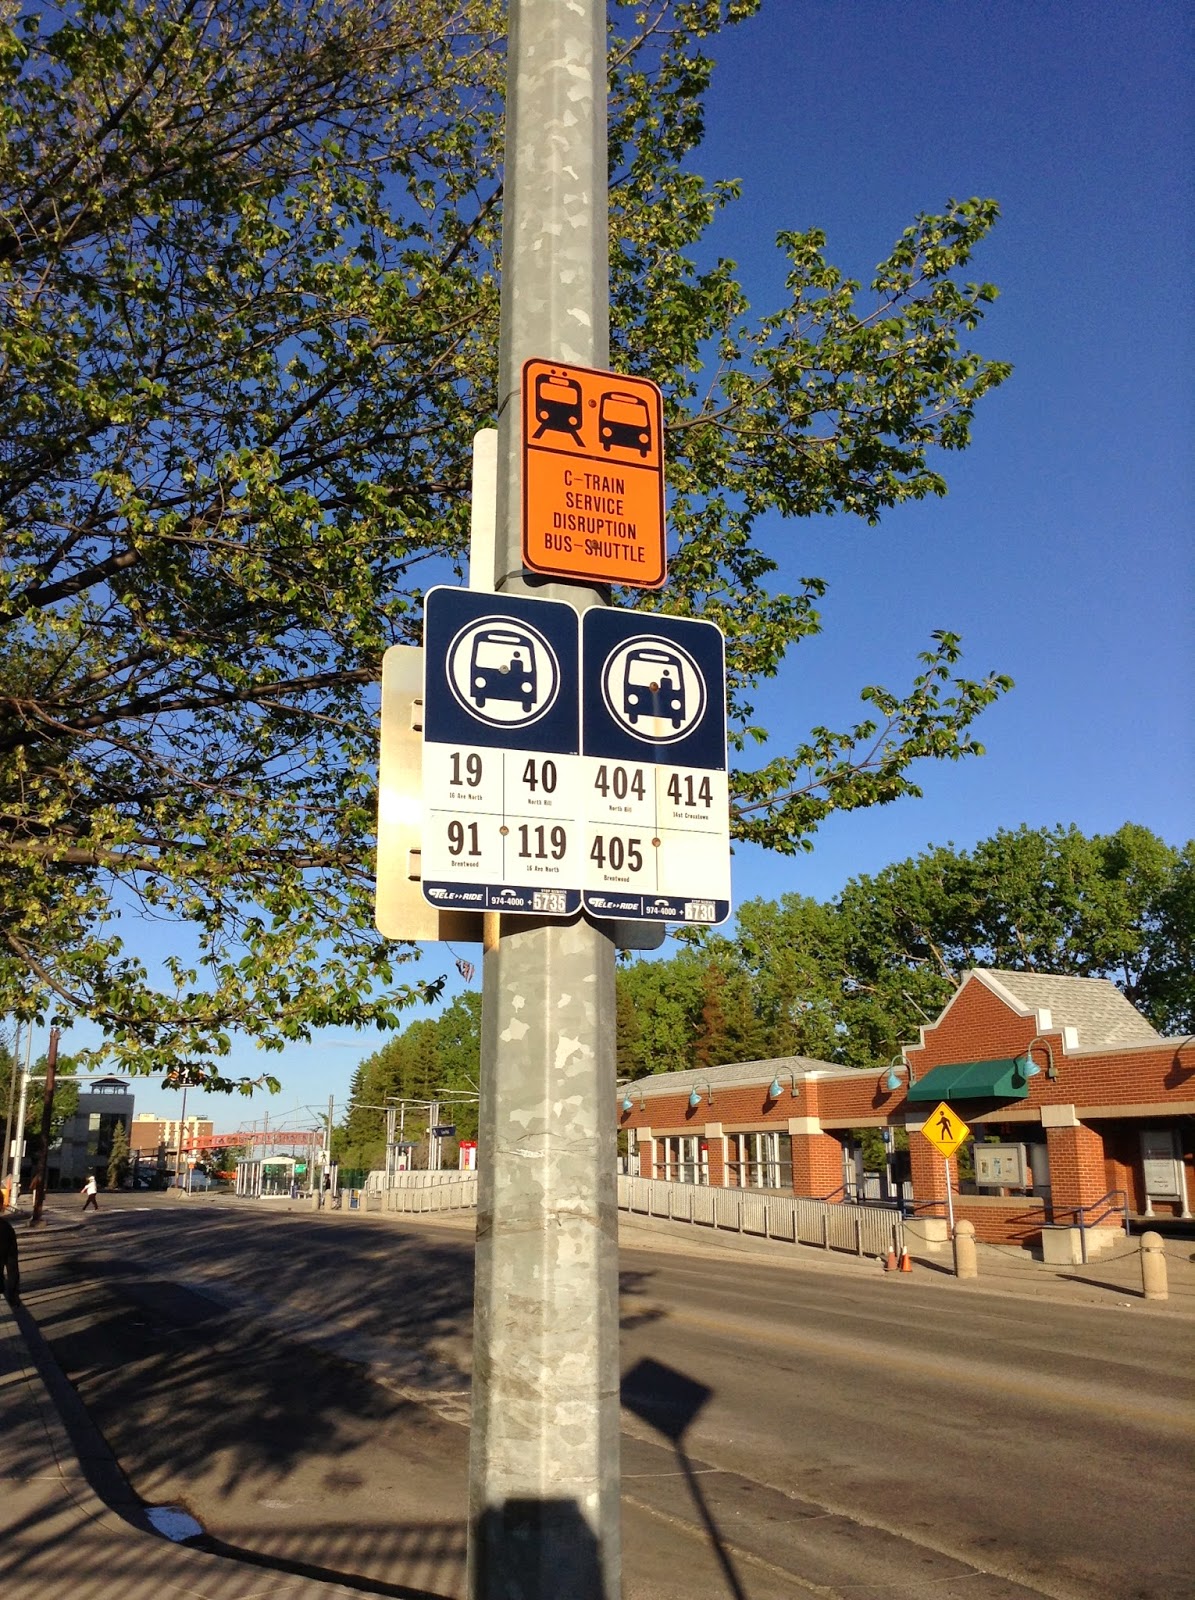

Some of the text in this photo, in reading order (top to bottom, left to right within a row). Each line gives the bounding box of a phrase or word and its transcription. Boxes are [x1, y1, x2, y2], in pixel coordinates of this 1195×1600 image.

[564, 469, 625, 495] C-TRAIN
[565, 491, 624, 516] SERVICE
[553, 511, 636, 540] DISRUPTION
[544, 532, 646, 563] BUS-SHUTTLE
[449, 751, 483, 788] 19
[522, 758, 558, 794] 40
[594, 764, 646, 802] 404
[667, 773, 713, 808] 414
[447, 820, 482, 856] 91
[518, 824, 567, 860] 119
[451, 860, 479, 868] Brentwood
[590, 835, 643, 872] 405
[603, 874, 630, 883] Brentwood
[462, 892, 484, 901] RIDE
[491, 896, 524, 906] 974-4000
[645, 906, 676, 916] 974-4000
